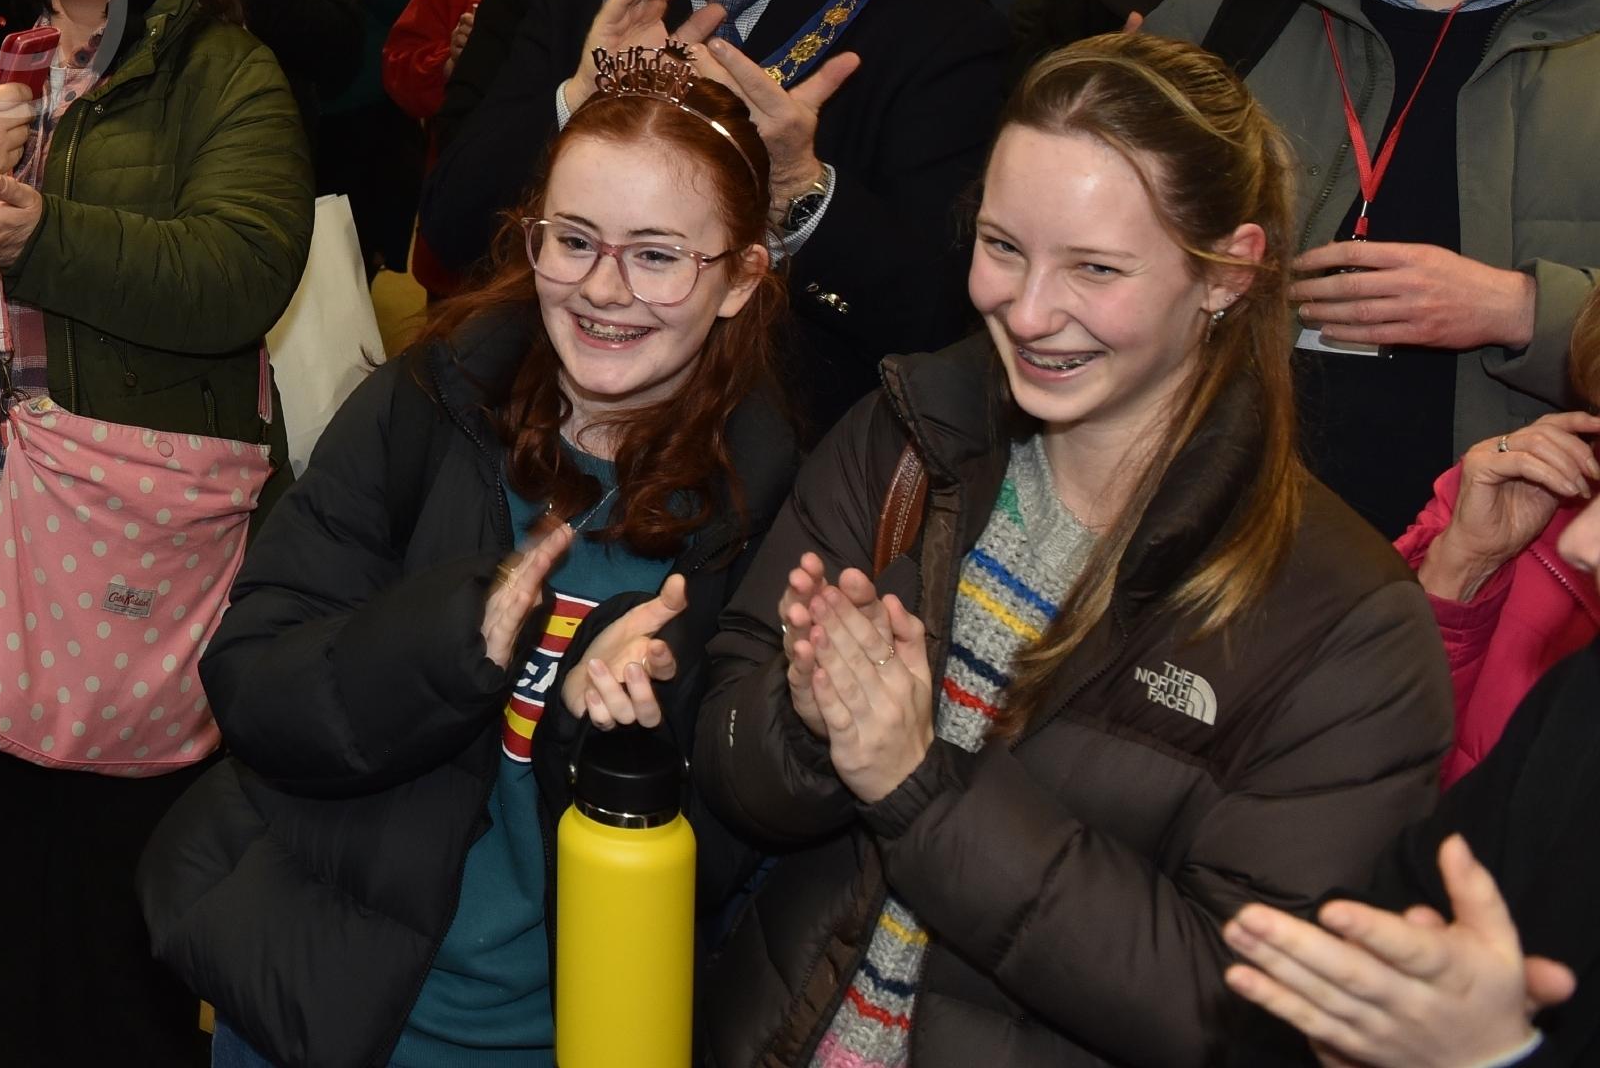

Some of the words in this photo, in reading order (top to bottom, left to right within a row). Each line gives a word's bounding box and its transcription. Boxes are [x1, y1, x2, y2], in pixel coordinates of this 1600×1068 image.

[1134, 666, 1192, 701] NORTH
[1163, 661, 1195, 686] THE
[1147, 685, 1188, 714] FACE
